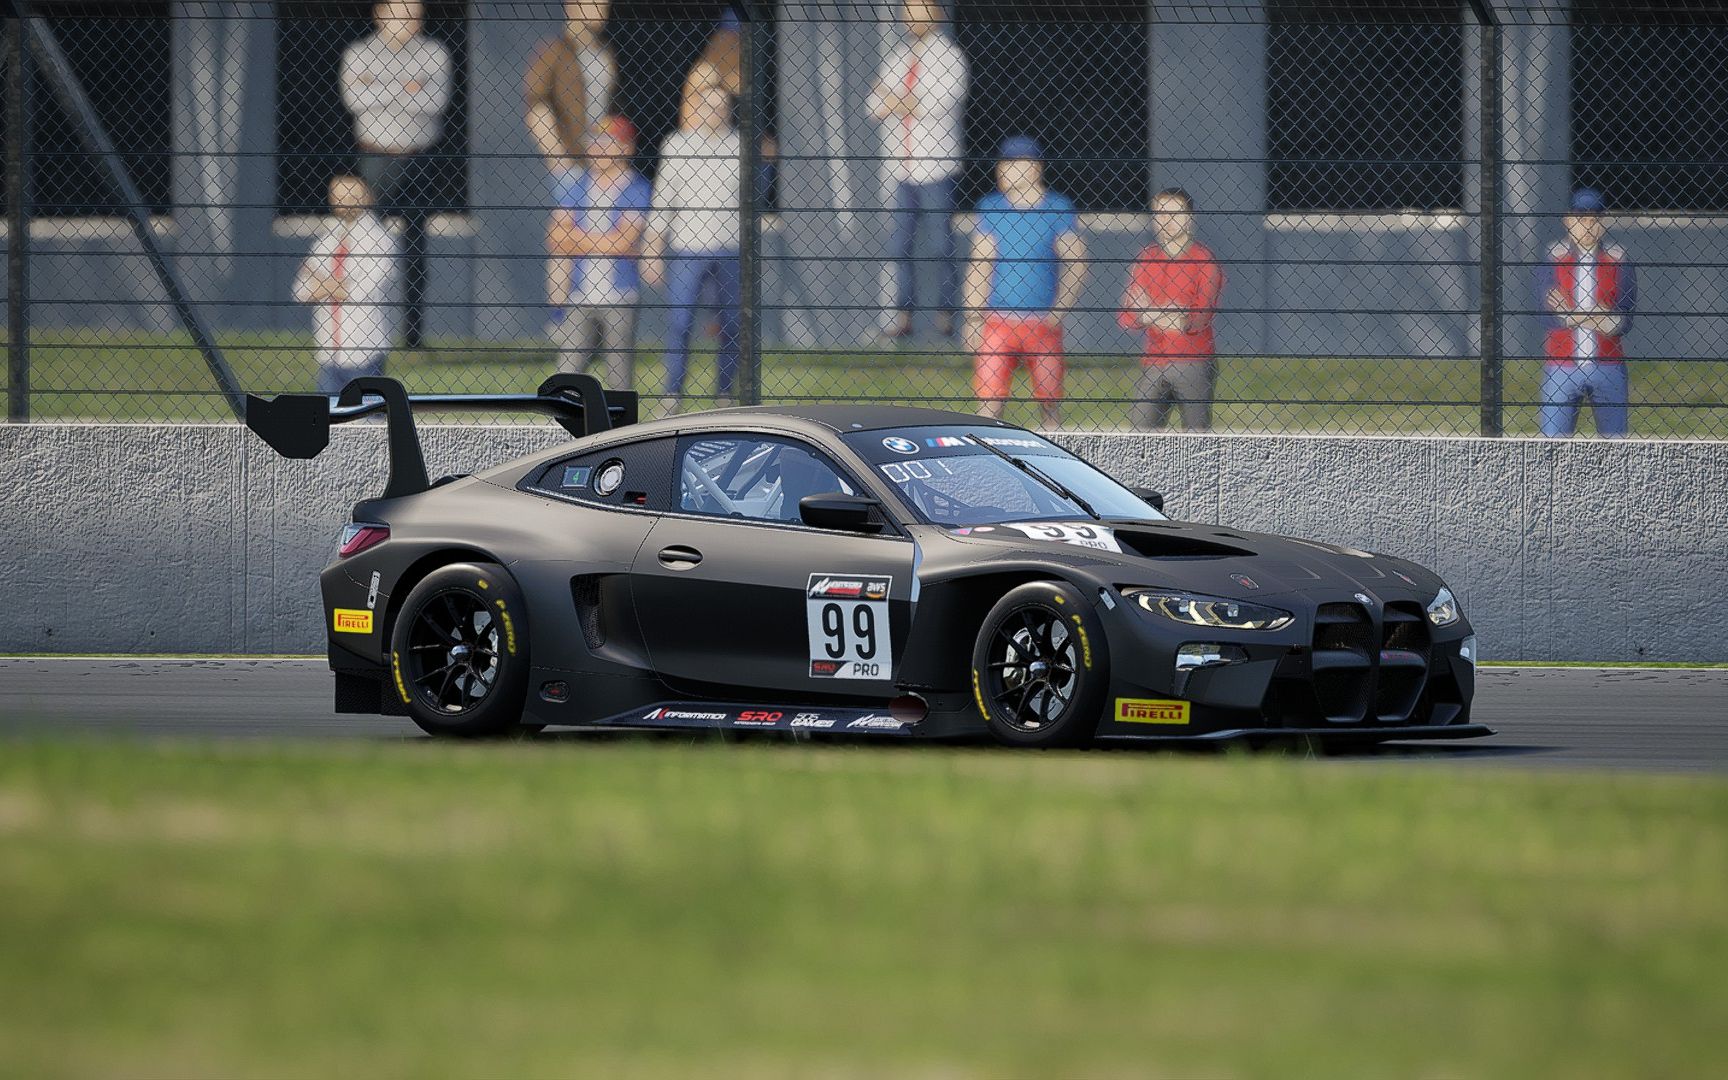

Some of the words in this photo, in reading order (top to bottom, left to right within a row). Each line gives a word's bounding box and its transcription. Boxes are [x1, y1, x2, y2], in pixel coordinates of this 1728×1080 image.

[572, 470, 580, 484] 4
[338, 614, 369, 629] PIRELLI
[822, 602, 876, 660] 99
[853, 663, 879, 677] PRO
[737, 711, 783, 722] SRO
[1122, 703, 1183, 719] PIRELLI
